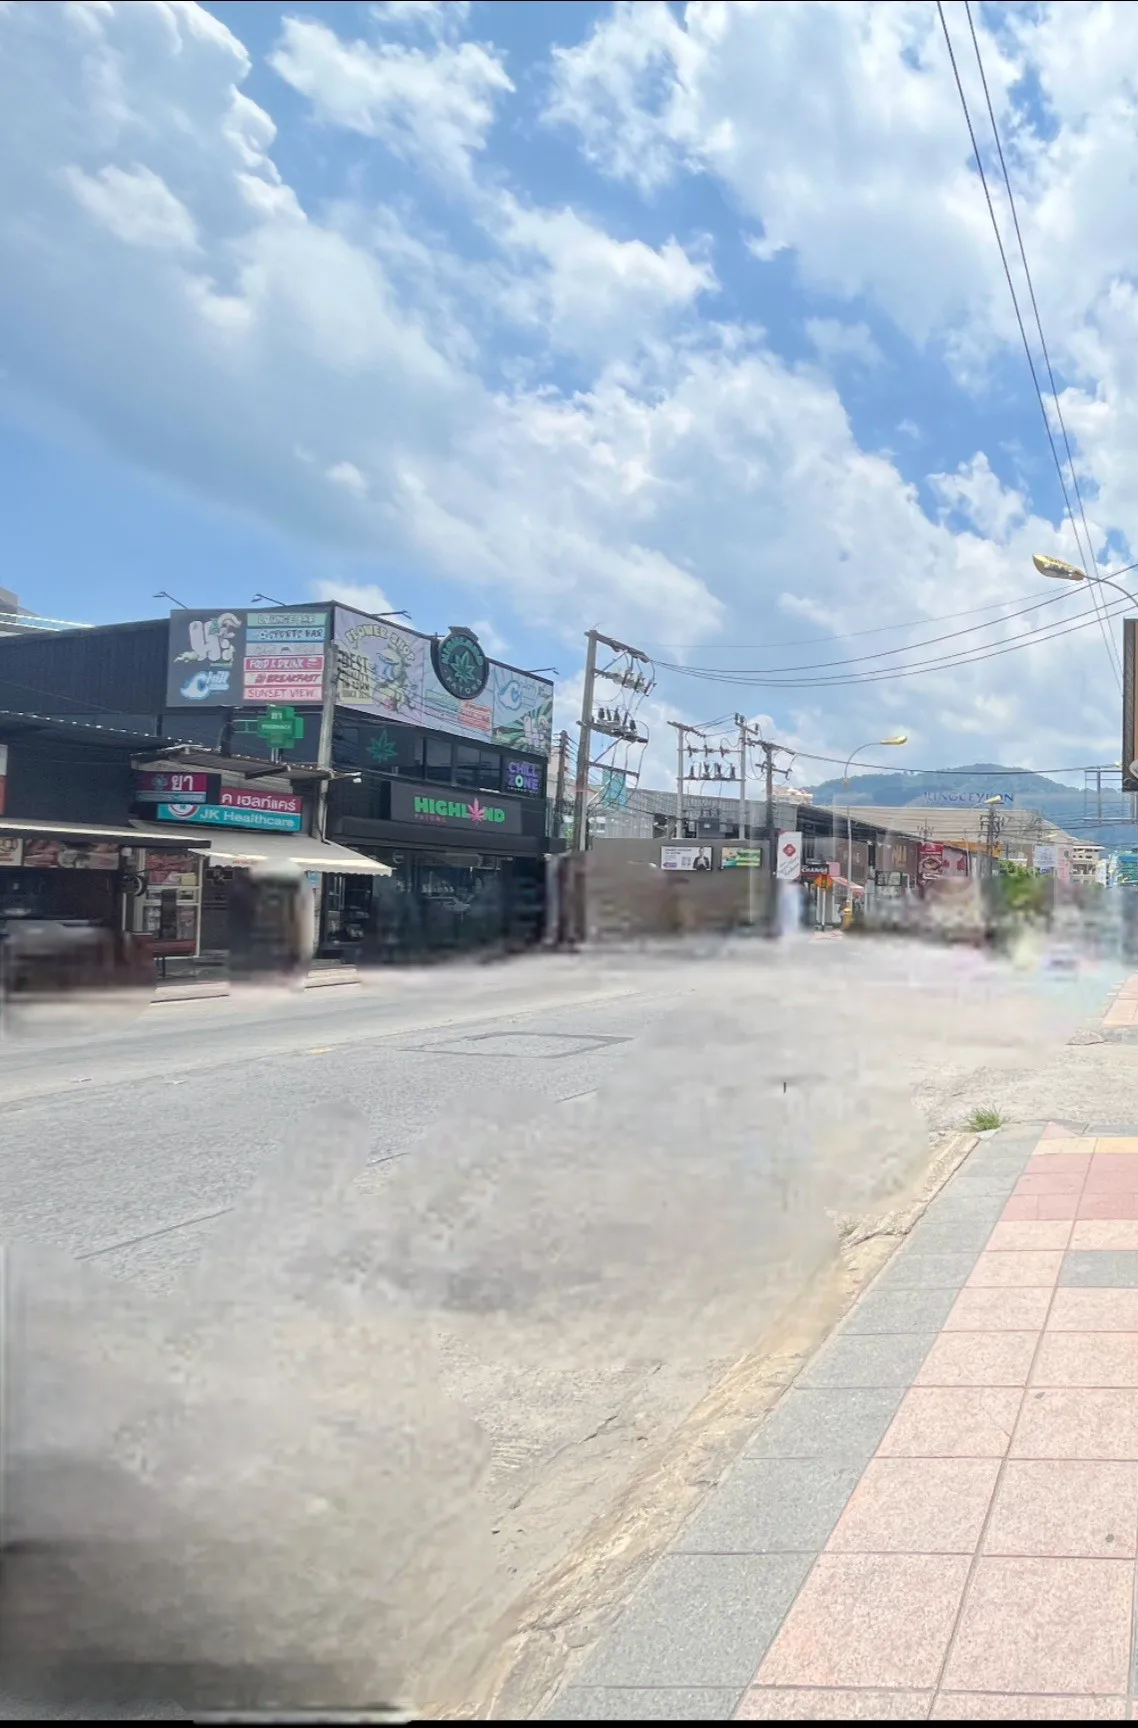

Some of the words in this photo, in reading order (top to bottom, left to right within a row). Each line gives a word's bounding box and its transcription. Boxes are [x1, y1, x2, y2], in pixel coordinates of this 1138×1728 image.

[266, 629, 303, 639] SPORTS
[305, 628, 323, 638] BAR
[388, 631, 416, 663] SHOP
[249, 659, 270, 668] FOOD
[277, 658, 304, 668] DRINK
[265, 673, 321, 683] BREAKFAST
[248, 688, 287, 698] SUNSET
[289, 688, 314, 698] VIEW
[508, 761, 537, 777] CHILL
[171, 774, 194, 791] ยา
[508, 774, 539, 790] ZONE
[200, 808, 220, 821] JK
[223, 811, 295, 828] Healthcare
